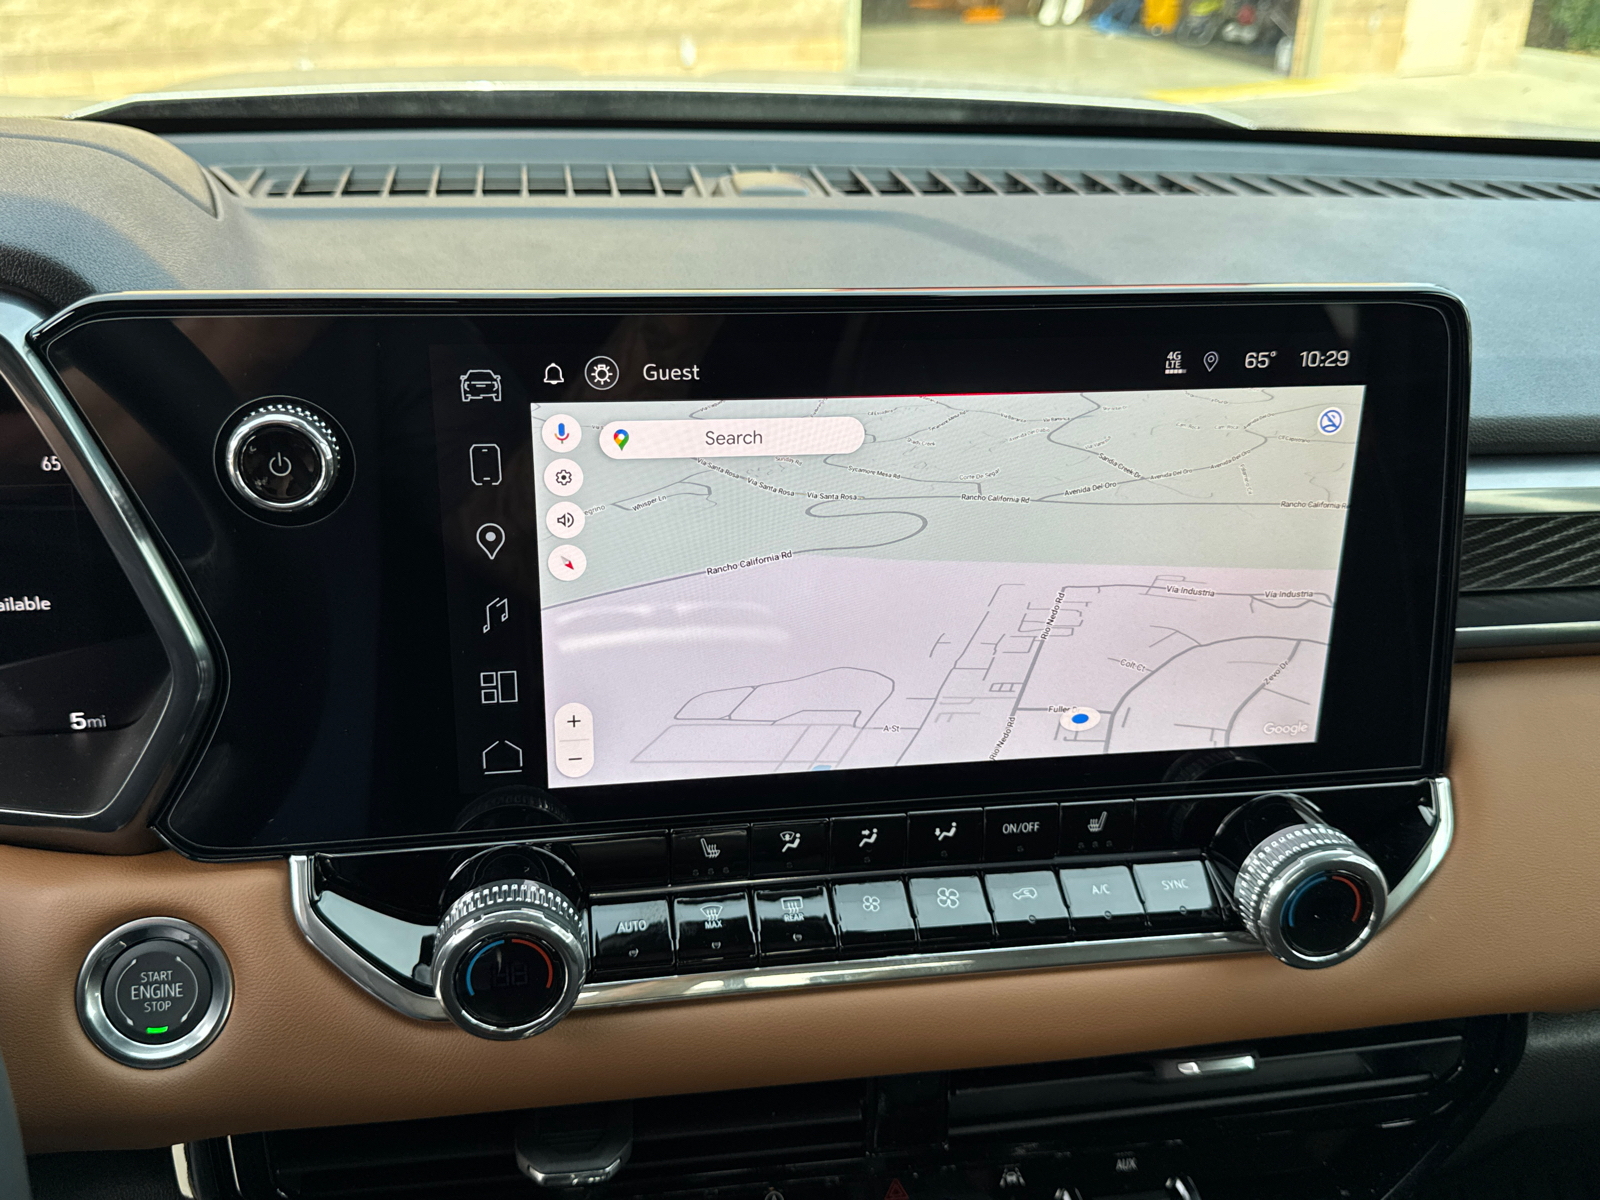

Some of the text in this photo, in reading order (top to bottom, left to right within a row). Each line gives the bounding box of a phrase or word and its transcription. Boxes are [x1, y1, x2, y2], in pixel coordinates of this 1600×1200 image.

[1166, 352, 1182, 360] 4G
[1244, 351, 1277, 369] 65°
[1300, 350, 1350, 368] 10:29
[1165, 360, 1182, 369] LTE
[642, 364, 700, 382] Guest
[705, 430, 763, 446] Search
[40, 456, 62, 472] 65
[697, 458, 740, 480] Via Santa Rosa
[1100, 452, 1118, 468] Sandia
[1118, 463, 1134, 476] Creek
[1210, 459, 1232, 470] Avenida
[848, 466, 876, 476] Sycamore
[876, 470, 892, 478] Mesa
[1150, 472, 1172, 480] Avenida
[747, 478, 795, 497] Via Santa Rosa
[1064, 486, 1092, 496] Avenida
[1092, 484, 1104, 492] Del
[806, 492, 819, 500] Via
[820, 492, 839, 500] Santa
[988, 494, 1020, 503] California
[632, 494, 667, 512] Whisper Ln
[1280, 500, 1306, 508] Rancho
[1308, 501, 1340, 509] California
[706, 550, 792, 576] Rancho California Rd
[1166, 585, 1215, 597] Via Industria
[1264, 590, 1314, 598] Via Industria
[1041, 592, 1066, 640] Rio Nedo Rd
[1120, 658, 1146, 672] Colt Ct
[1264, 660, 1290, 686] Zevo Dr
[1048, 705, 1070, 713] Fuller
[891, 724, 900, 733] St
[1263, 721, 1309, 736] Google
[988, 716, 1016, 761] Rio Nedo Rd
[1002, 822, 1040, 834] ON/OFF
[1092, 884, 1111, 896] A/C
[1161, 878, 1189, 891] SYNC
[784, 912, 804, 922] REAR
[617, 920, 648, 934] AUTO
[704, 920, 723, 929] MAX
[140, 970, 173, 983] START
[130, 983, 184, 1000] ENGINE
[144, 1000, 172, 1013] STOP
[1115, 1157, 1138, 1172] AUX
